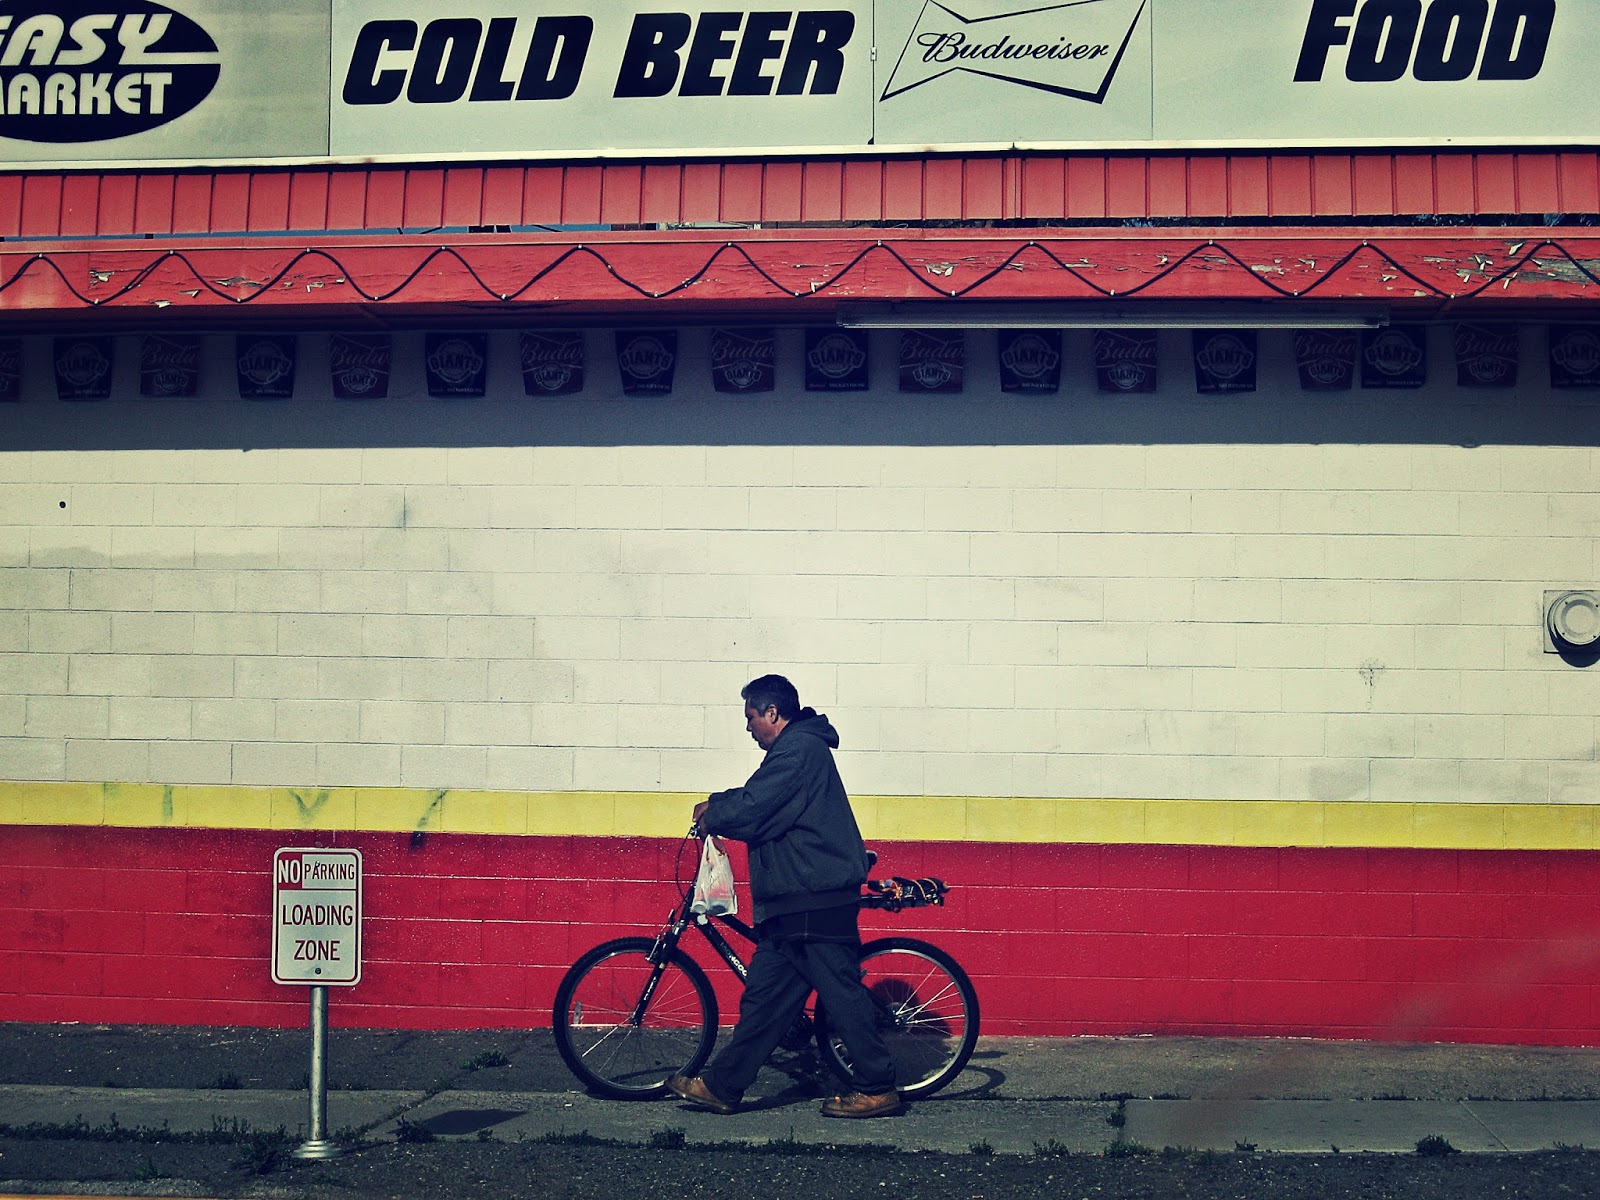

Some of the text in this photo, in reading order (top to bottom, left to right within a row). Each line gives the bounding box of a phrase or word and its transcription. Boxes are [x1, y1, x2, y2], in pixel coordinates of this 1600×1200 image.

[0, 13, 173, 66] ASY
[916, 32, 1109, 63] Budweiser
[1292, 0, 1556, 82] FOOD
[343, 10, 855, 105] COLD BEER
[0, 72, 173, 115] ARKET
[428, 352, 484, 373] GIANTS
[618, 349, 673, 371] GIANTS
[808, 347, 866, 369] GIANTS
[912, 367, 951, 382] GIANTS
[278, 859, 355, 884] NO PARKING
[282, 904, 353, 926] LOADING
[293, 940, 340, 961] ZONE
